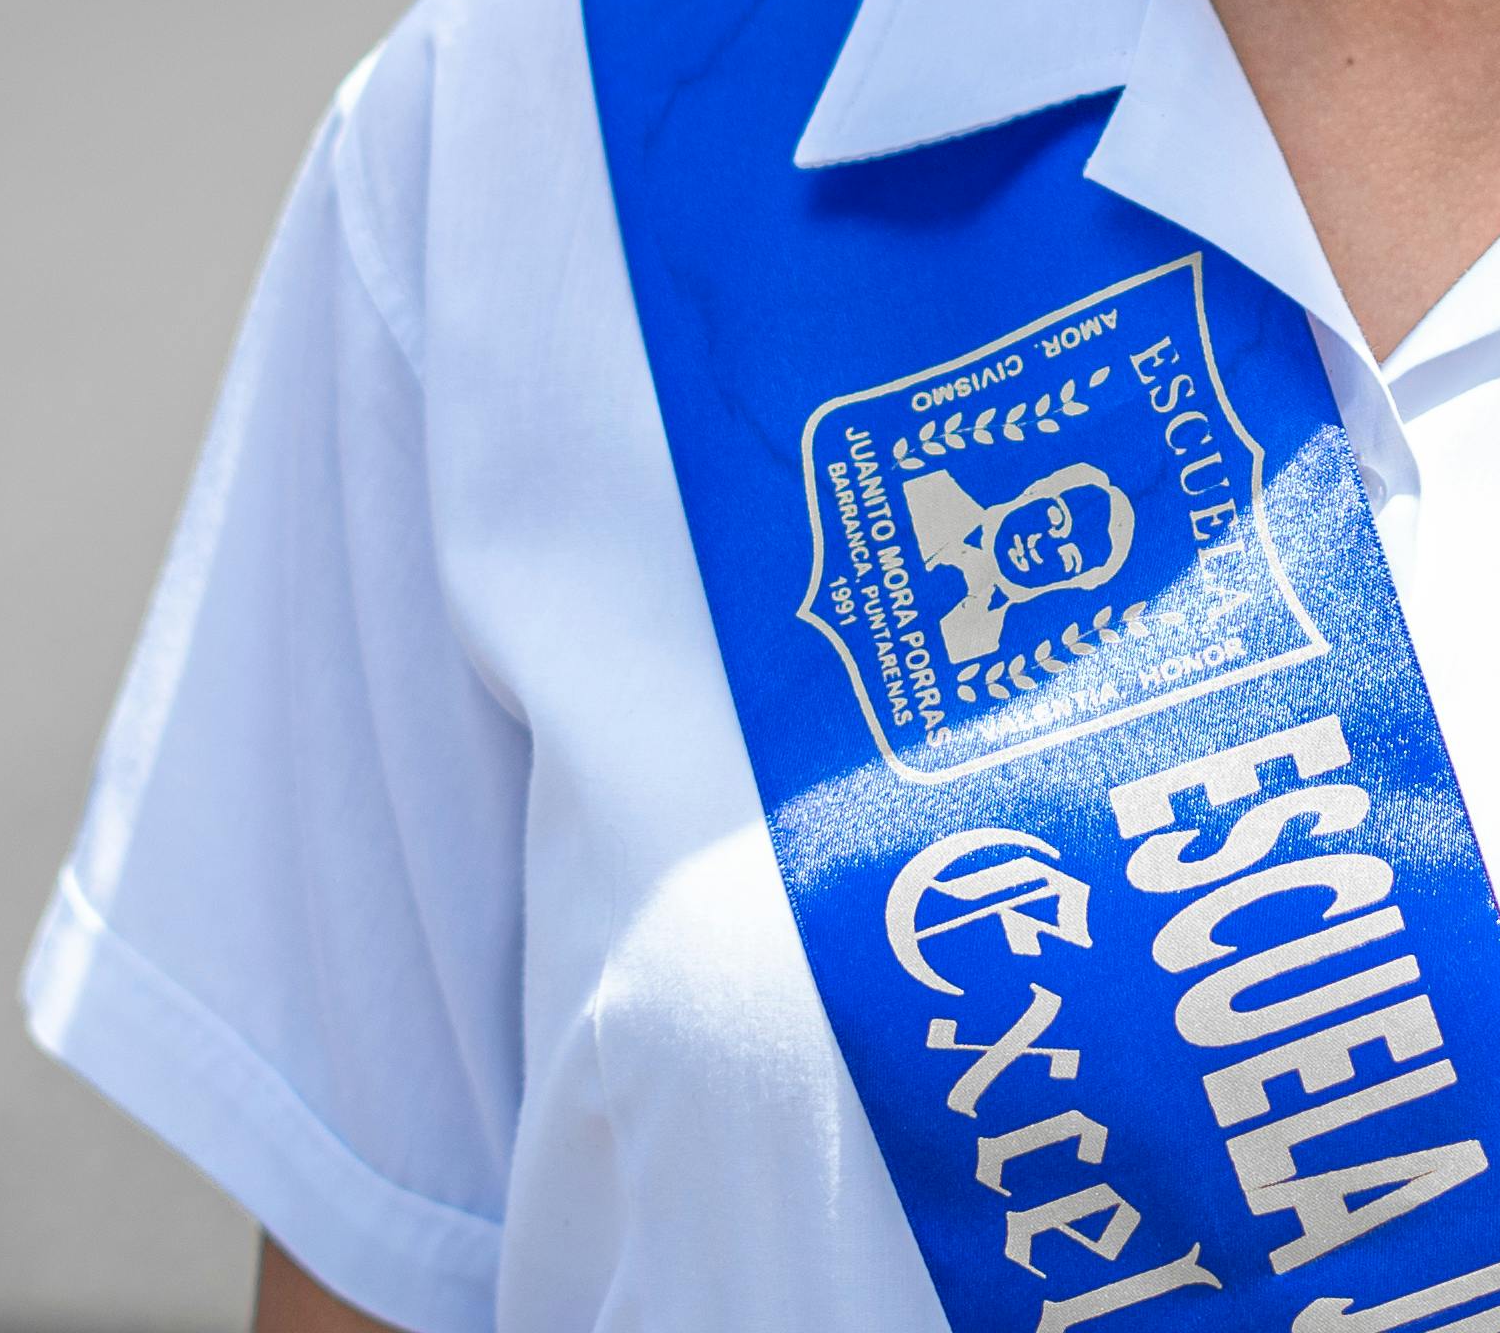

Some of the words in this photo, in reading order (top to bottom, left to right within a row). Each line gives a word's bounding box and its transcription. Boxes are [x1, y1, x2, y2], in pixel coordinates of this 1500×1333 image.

[911, 354, 1024, 412] CIVISMO
[1129, 336, 1251, 624] ESCUELA
[829, 576, 856, 626] 1991
[845, 427, 896, 541] JUANITO
[877, 545, 918, 628] MORA
[900, 631, 952, 748] PORRAS
[861, 585, 913, 726] PUNTARENAS
[1138, 637, 1246, 689] HONOR
[1109, 715, 1489, 1275] ESCUELA
